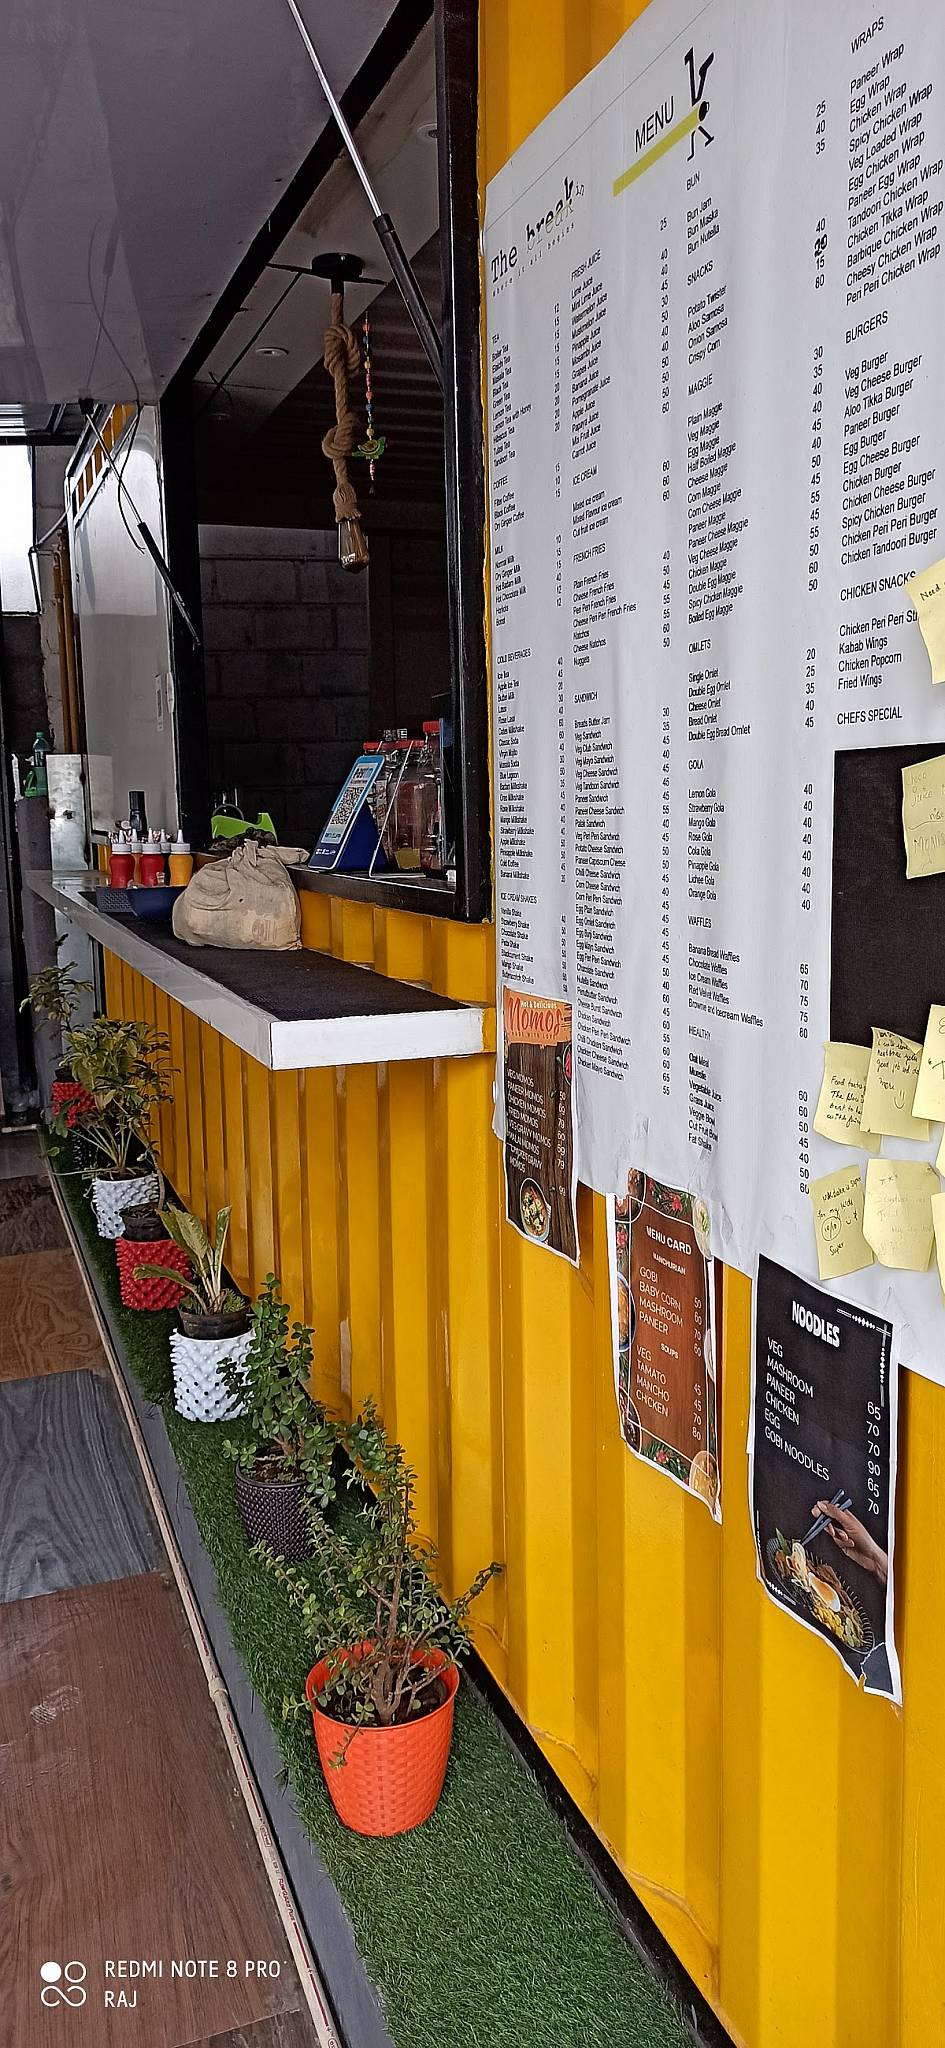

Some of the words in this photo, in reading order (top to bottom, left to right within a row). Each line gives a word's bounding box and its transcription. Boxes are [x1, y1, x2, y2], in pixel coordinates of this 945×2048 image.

[851, 16, 884, 54] WRAPS
[850, 63, 880, 94] Paneer
[881, 43, 904, 69] Wrap
[850, 94, 866, 114] Egg
[868, 75, 890, 99] Wrap
[816, 100, 826, 118] 25
[849, 102, 882, 133] Chicken
[884, 82, 907, 107] Wrap
[849, 130, 871, 153] Spicy
[872, 102, 907, 135] Chicken
[909, 83, 933, 108] Wrap
[634, 96, 675, 153] MENU
[816, 119, 826, 135] 40
[848, 154, 864, 171] Veg
[866, 127, 897, 160] Loaded
[899, 112, 922, 136] Wrap
[686, 171, 700, 191] BUN
[883, 176, 918, 206] Chicken
[920, 159, 944, 182] Wrap
[686, 208, 699, 222] Bun
[699, 197, 712, 213] Jam
[687, 240, 699, 255] Bun
[700, 223, 720, 245] Nutella
[847, 239, 882, 268] Barbique
[883, 217, 918, 245] Chicken
[920, 200, 944, 223] Wrap
[491, 246, 518, 284] The
[816, 255, 825, 270] 15
[846, 261, 876, 287] Cheesy
[877, 241, 912, 268] Chicken
[914, 225, 937, 247] Wrap
[687, 260, 714, 286] SNACKS
[815, 274, 825, 289] 80
[846, 287, 862, 306] Peri
[863, 276, 880, 296] Peri
[881, 259, 915, 285] Chicken
[917, 243, 941, 265] Wrap
[660, 279, 669, 291] 45
[687, 298, 706, 318] Potato
[706, 285, 727, 305] Twister
[688, 332, 705, 349] Onion
[705, 317, 728, 338] Samosa
[845, 310, 888, 344] BURGERS
[813, 345, 823, 360] 30
[844, 366, 860, 381] Veg
[861, 351, 889, 373] Burger
[688, 373, 713, 396] MAGGIE
[844, 403, 861, 419] Aloo
[863, 392, 883, 410] Tikka
[885, 378, 914, 400] Burger
[687, 412, 702, 427] Plain
[703, 401, 723, 419] Maggie
[812, 418, 822, 432] 45
[844, 416, 871, 437] Paneer
[872, 404, 901, 425] Burger
[811, 455, 821, 468] 50
[843, 460, 858, 475] Egg
[860, 446, 890, 468] Cheese
[891, 435, 920, 455] Burger
[842, 473, 873, 492] Chicken
[874, 461, 902, 480] Burger
[842, 529, 871, 547] Chicken
[872, 521, 889, 538] Peri
[890, 515, 908, 532] Peri
[909, 508, 938, 526] Burger
[573, 549, 591, 564] FRENCH
[591, 543, 606, 556] FRIES
[841, 548, 871, 565] Chicken
[908, 528, 938, 546] Burger
[808, 561, 819, 574] 60
[840, 582, 877, 601] CHICKEN
[919, 583, 941, 601] Need
[839, 621, 870, 637] Chicken
[871, 616, 886, 631] Peri
[887, 612, 904, 627] Peri
[688, 638, 711, 654] OMLETS
[839, 641, 864, 655] Kabab
[866, 636, 888, 650] Wings
[838, 657, 869, 672] Chicken
[871, 652, 902, 667] Popcorn
[805, 682, 815, 694] 35
[838, 678, 858, 690] Fried
[860, 674, 883, 688] Wings
[574, 691, 598, 704] SANDWICH
[662, 707, 670, 717] 30
[837, 710, 867, 725] CHEFS
[868, 706, 903, 722] SPECIAL
[688, 759, 704, 770] GOLA
[688, 788, 705, 799] Lemon
[705, 787, 717, 798] Gola
[803, 783, 813, 795] 40
[688, 915, 712, 928] WAFFLES
[799, 963, 809, 975] 65
[799, 980, 809, 991] 70
[688, 1025, 711, 1040] HEALTHY
[799, 1137, 809, 1148] 45
[646, 1225, 666, 1245] MENU
[667, 1237, 692, 1256] CARD
[640, 1266, 658, 1283] GOBI
[639, 1280, 660, 1299] BABY
[660, 1291, 681, 1311] CORN
[694, 1297, 702, 1309] 50
[639, 1295, 683, 1328] MASHROOM
[639, 1311, 669, 1336] PANEER
[791, 1300, 840, 1349] NOODLES
[636, 1344, 652, 1362] VEG
[660, 1342, 679, 1360] SOUPS
[767, 1336, 783, 1358] VEG
[636, 1358, 667, 1385] TAMATO
[767, 1354, 814, 1398] MASHROOM
[636, 1373, 670, 1402] MANCHO
[693, 1383, 702, 1396] 45
[766, 1372, 796, 1405] PANEER
[635, 1389, 669, 1417] CHICKEN
[765, 1390, 800, 1425] CHICKEN
[867, 1401, 881, 1421] 65
[764, 1408, 781, 1430] EGG
[866, 1421, 880, 1437] 70
[692, 1426, 701, 1441] 80
[764, 1426, 783, 1451] GOBI
[784, 1442, 830, 1482] NOODLES
[867, 1441, 880, 1457] 70
[867, 1460, 881, 1476] 90
[867, 1477, 880, 1498] 65
[867, 1498, 880, 1515] 70
